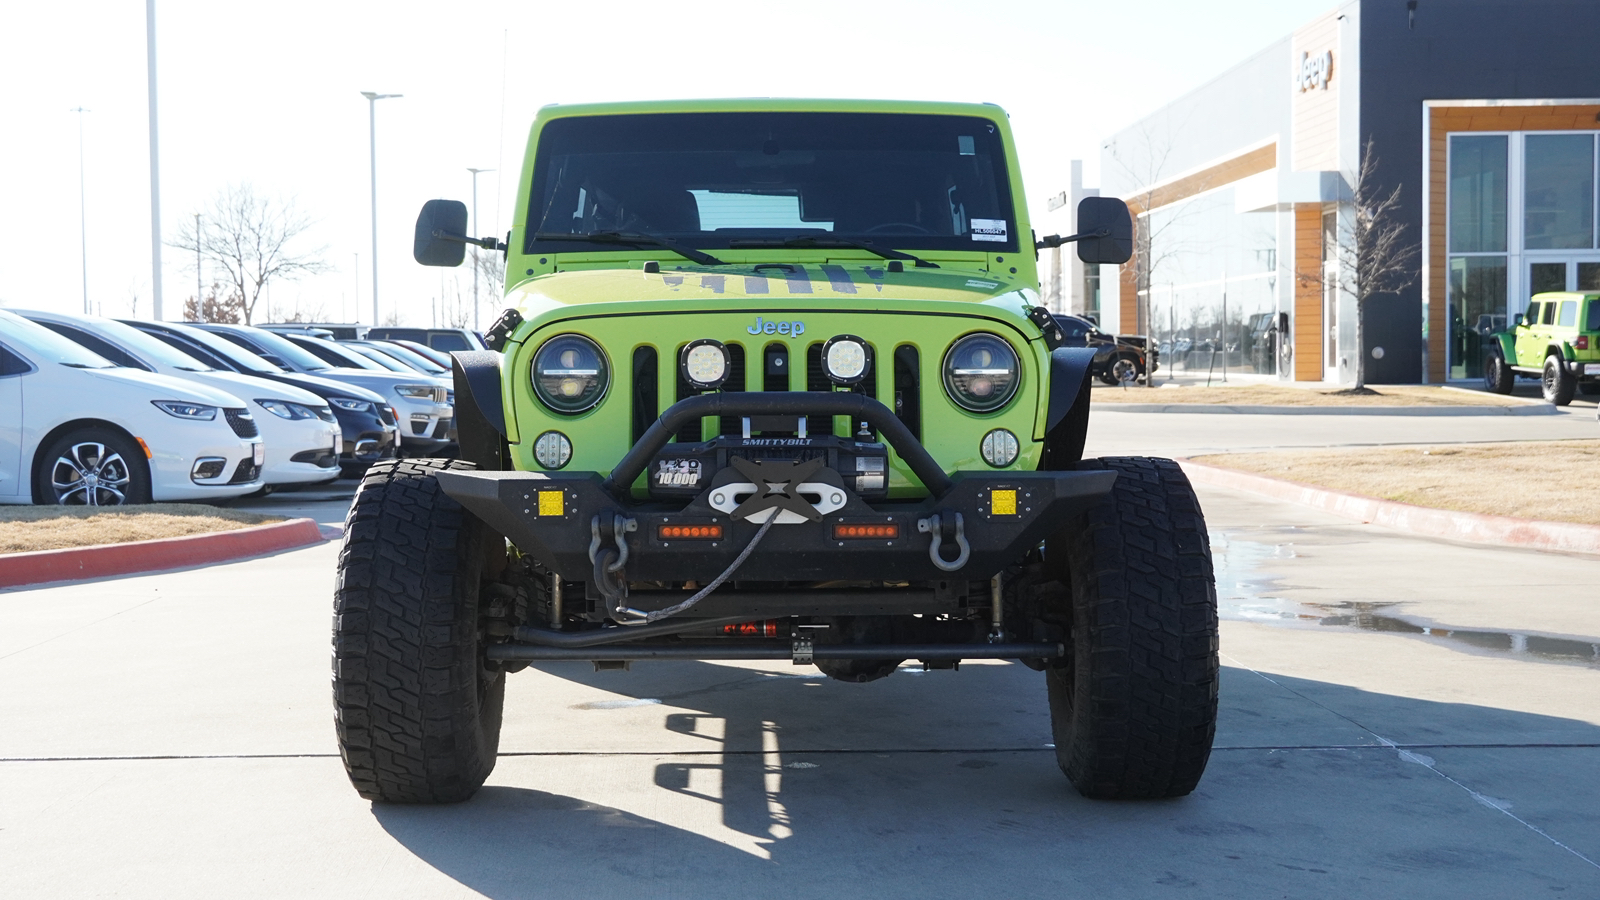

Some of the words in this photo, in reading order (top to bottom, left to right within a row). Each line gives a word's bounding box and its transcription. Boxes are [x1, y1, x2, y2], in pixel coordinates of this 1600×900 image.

[1296, 50, 1333, 93] Jeep
[747, 316, 805, 338] Jeep
[742, 438, 812, 446] SMITTYBILT
